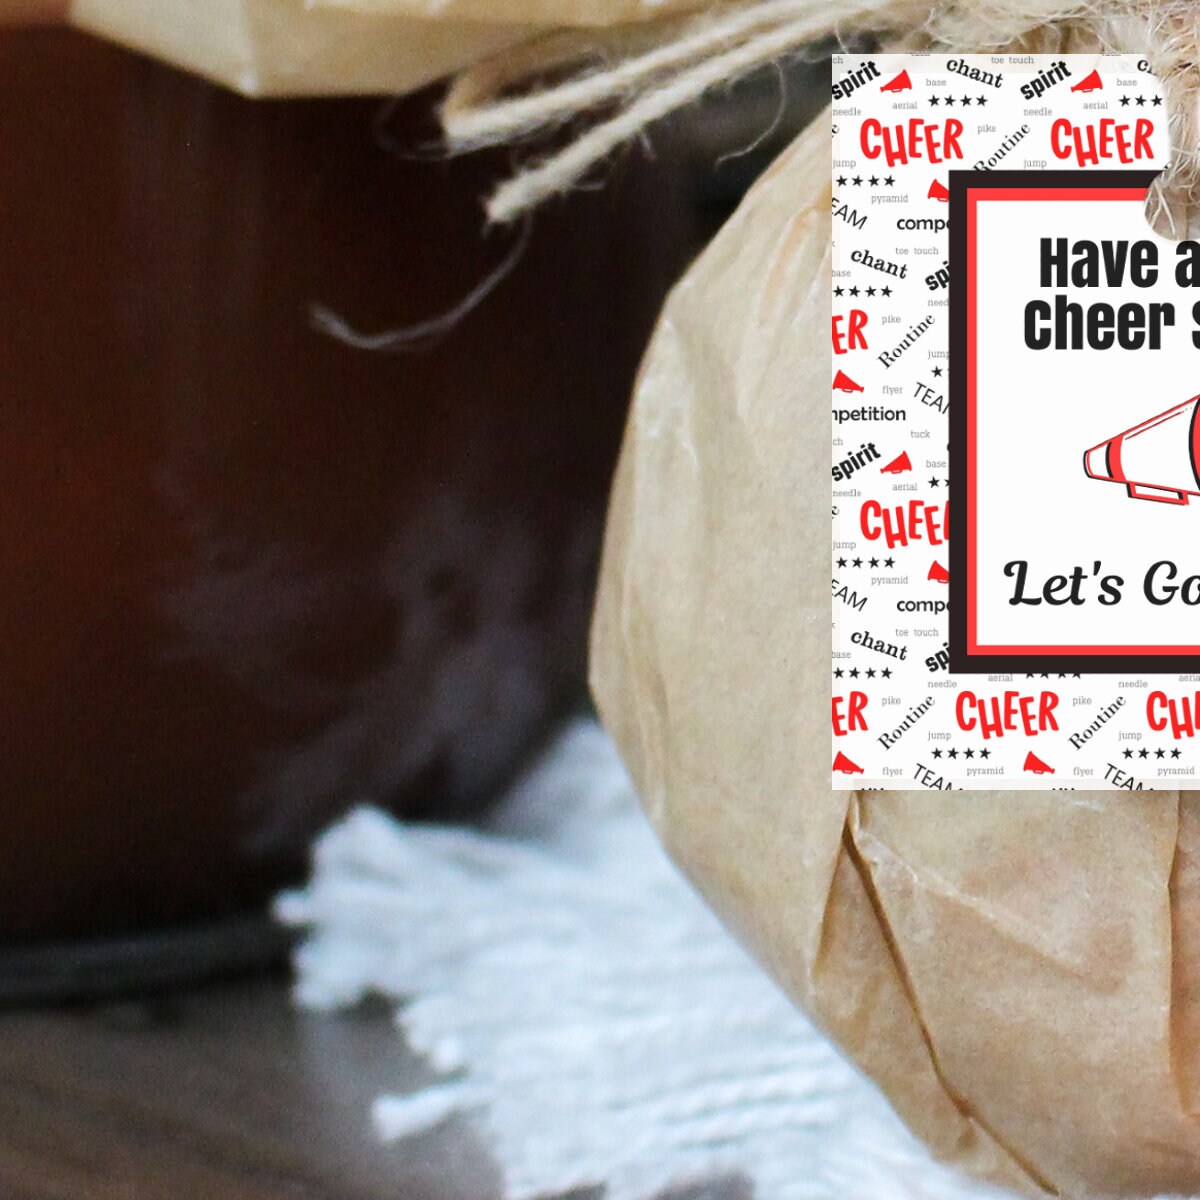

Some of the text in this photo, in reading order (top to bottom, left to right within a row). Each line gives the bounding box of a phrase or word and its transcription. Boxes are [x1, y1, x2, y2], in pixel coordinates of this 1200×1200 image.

[991, 56, 1034, 64] toe touch
[946, 59, 1003, 88] chant
[1020, 60, 1072, 100] spirit
[892, 101, 918, 109] aerial
[1083, 101, 1108, 109] aerial
[833, 106, 862, 116] needle
[1023, 106, 1052, 116] needle
[977, 124, 996, 134] pike
[860, 118, 964, 167] CHEER
[1050, 118, 1154, 167] CHEER
[833, 158, 856, 169] jump
[1023, 158, 1047, 169] jump
[871, 194, 908, 204] pyramid
[895, 247, 939, 255] toe touch
[851, 249, 908, 279] chant
[1040, 238, 1158, 288] Have
[928, 297, 949, 307] need
[882, 315, 901, 325] pike
[1025, 295, 1176, 351] Cheer
[876, 315, 936, 369] Routine
[882, 385, 903, 395] flyer
[911, 430, 930, 438] tuck
[925, 460, 947, 468] base
[892, 482, 918, 491] aerial
[833, 488, 862, 498] needle
[833, 540, 856, 550] jump
[871, 575, 908, 586] pyramid
[1003, 560, 1125, 606] Let's
[895, 628, 939, 636] toe touch
[851, 631, 908, 660] chant
[988, 673, 1013, 681] aerial
[928, 678, 957, 688] needle
[1119, 678, 1148, 688] needle
[882, 696, 901, 706] pike
[1073, 696, 1091, 706] pike
[955, 690, 1059, 739] CHEER
[876, 696, 936, 751] Routine
[1067, 696, 1126, 751] Routine
[928, 730, 952, 741] jump
[1119, 730, 1142, 741] jump
[882, 766, 903, 776] flyer
[966, 766, 1004, 776] pyramid
[1072, 766, 1093, 776] flyer
[1157, 766, 1194, 776] pyramid
